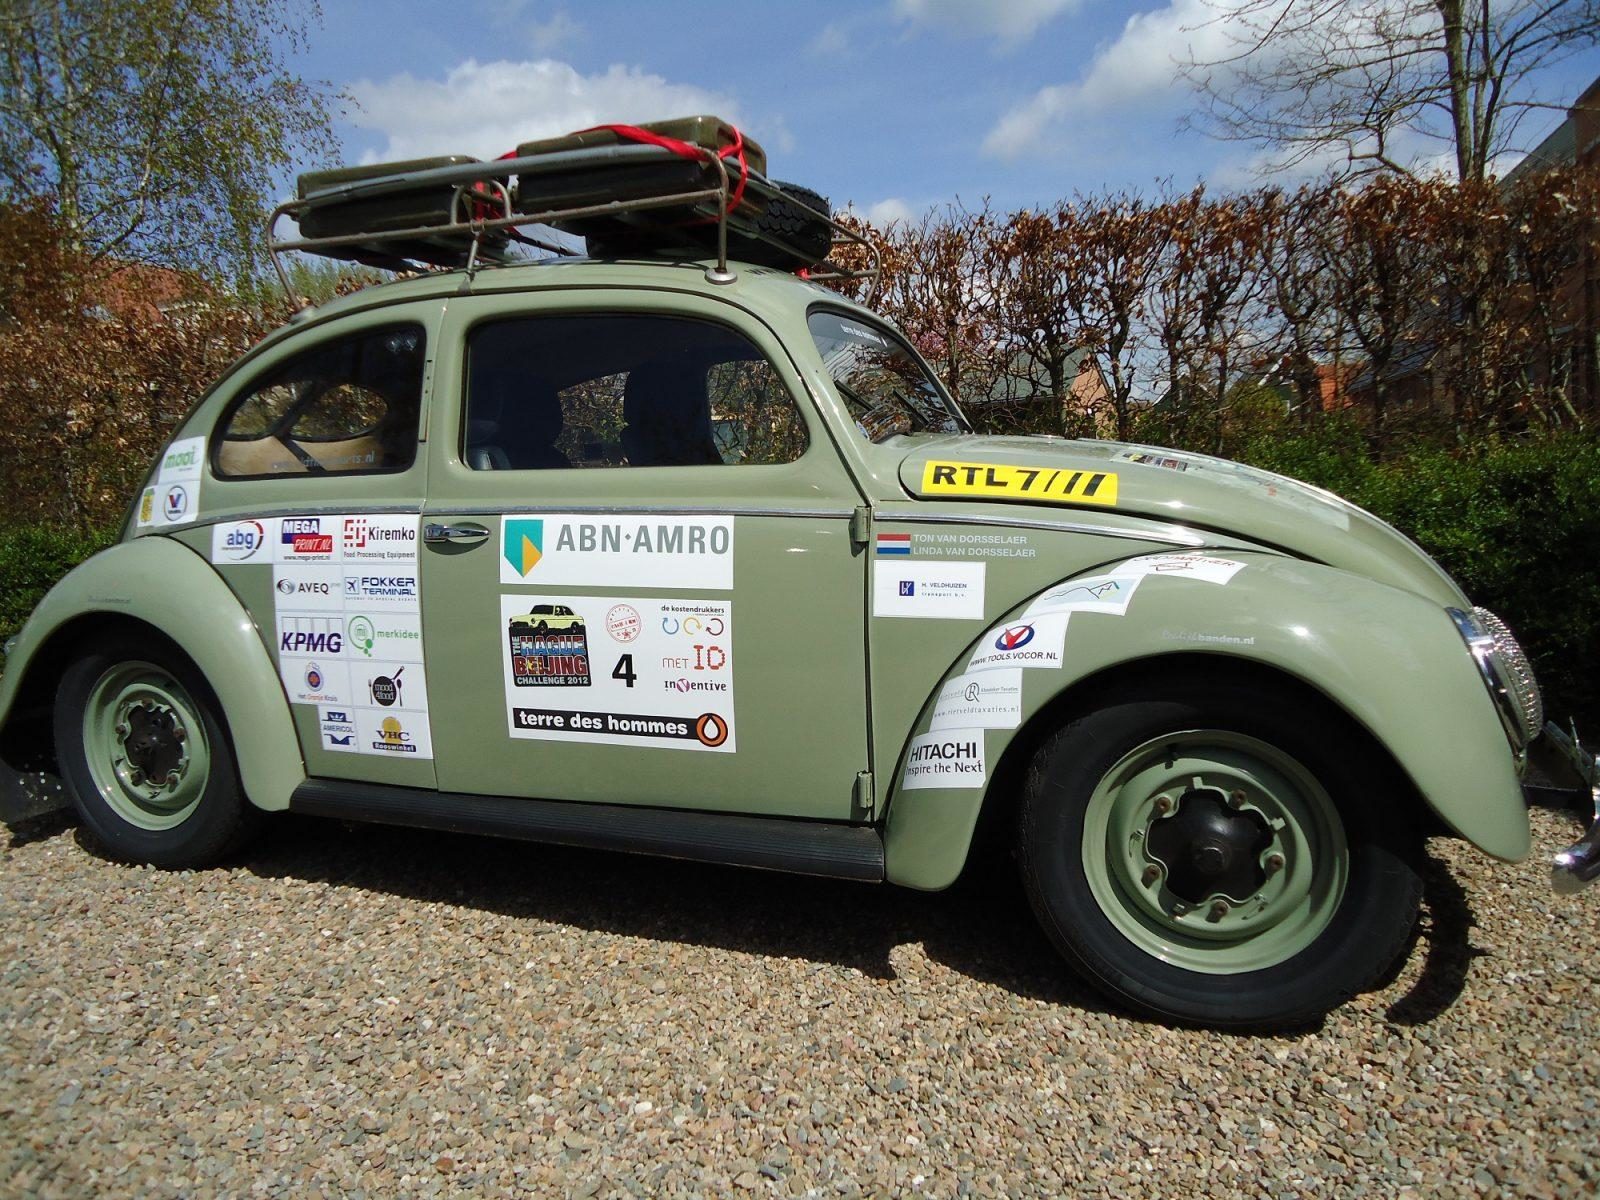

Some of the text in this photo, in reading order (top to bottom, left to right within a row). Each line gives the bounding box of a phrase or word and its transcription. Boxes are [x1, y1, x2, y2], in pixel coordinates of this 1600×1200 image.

[282, 520, 319, 534] MEGA
[368, 526, 415, 541] Kiremko
[227, 529, 254, 550] abg
[293, 538, 332, 551] PRINT.NL
[913, 534, 1027, 545] TON VAN DORSSELAER
[357, 551, 385, 559] Processing
[387, 552, 415, 560] Equipment
[913, 547, 1036, 558] LINDA VAN DORSSELAER
[298, 582, 329, 595] AVEQ
[361, 577, 415, 587] FOKKER
[361, 587, 416, 596] TERMINAL
[671, 605, 725, 614] kostendrukkers
[377, 630, 419, 639] merkidee
[281, 631, 342, 653] KPMG
[512, 636, 521, 655] THE
[520, 635, 586, 656] HAGUE
[514, 655, 588, 676] BEIJING
[611, 654, 637, 688] 4
[517, 676, 589, 685] CHALLENGE 2012
[323, 725, 354, 734] AMERICOL
[519, 711, 688, 735] terre des hommes
[376, 730, 410, 742] VHC
[910, 742, 977, 762] HITACHI
[905, 760, 982, 777] Inspire the Next
